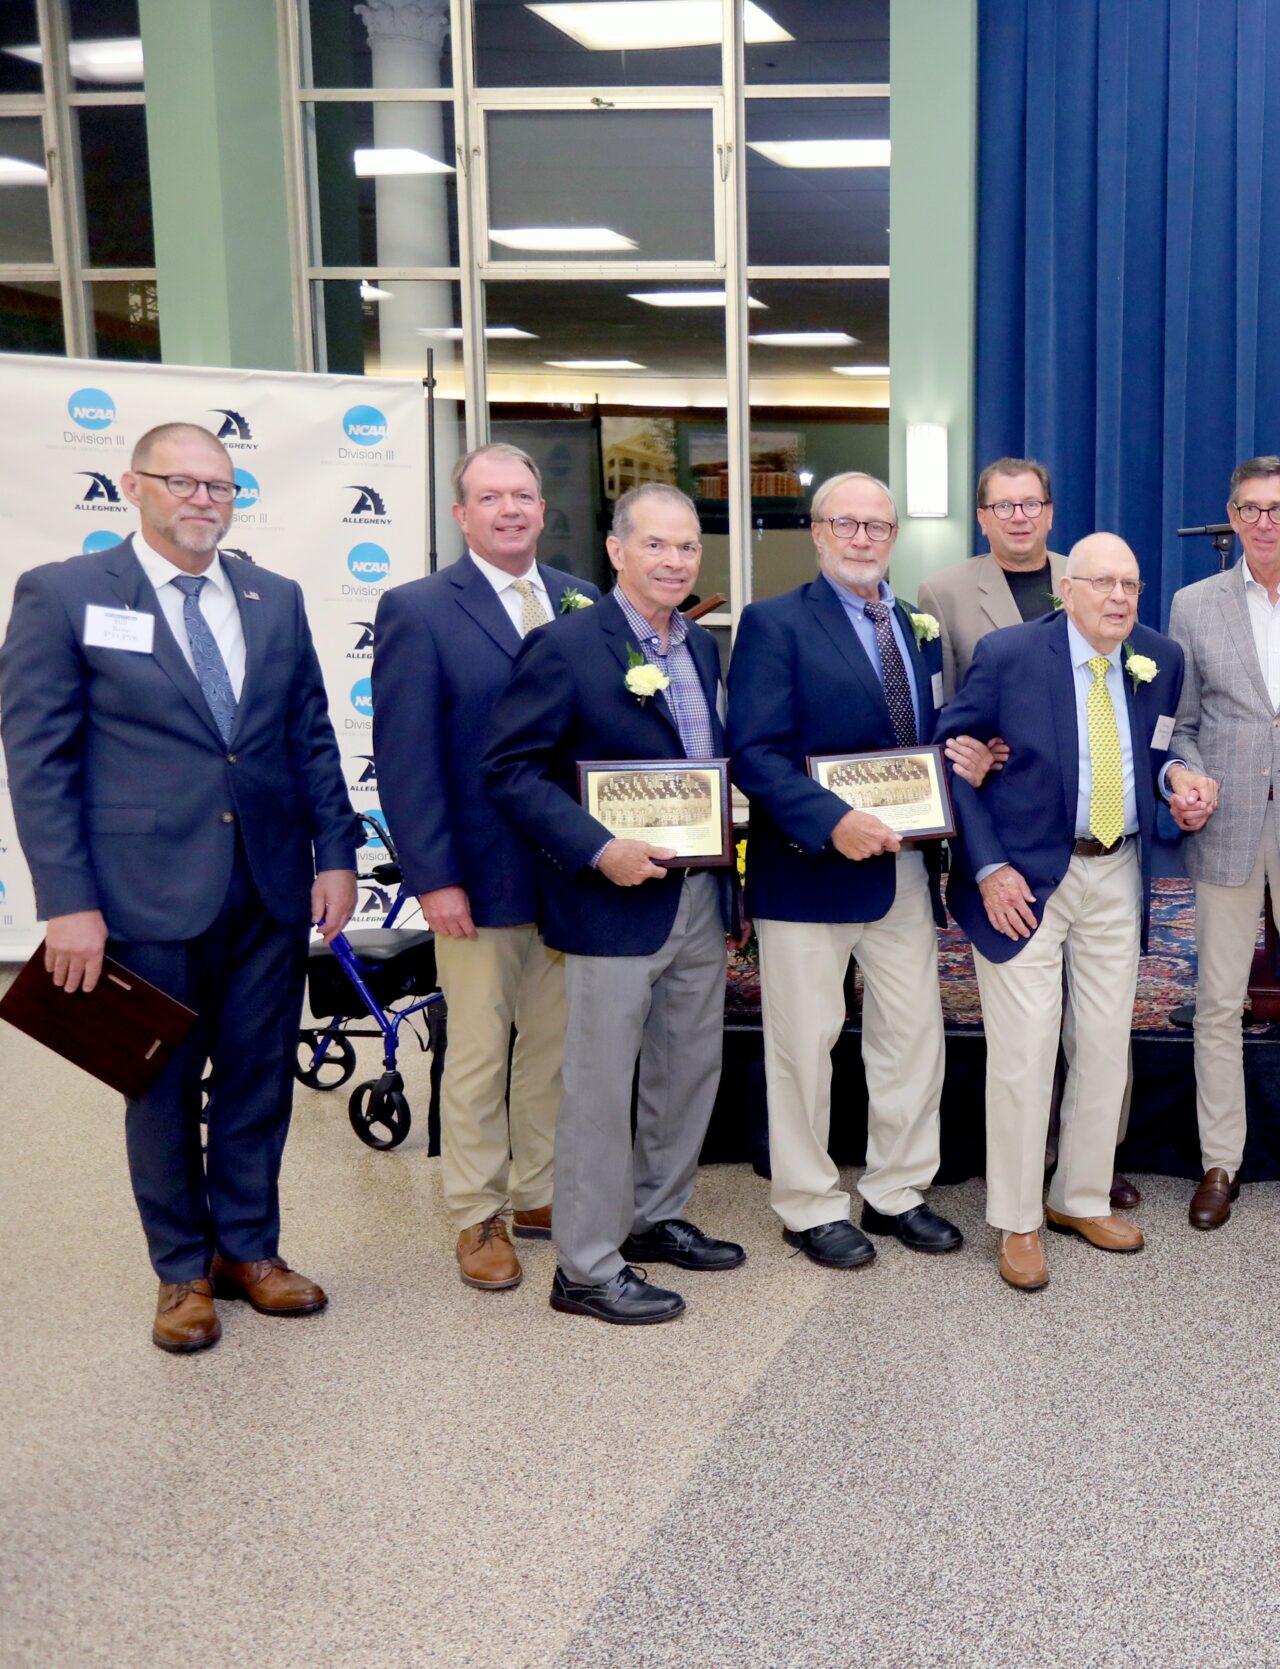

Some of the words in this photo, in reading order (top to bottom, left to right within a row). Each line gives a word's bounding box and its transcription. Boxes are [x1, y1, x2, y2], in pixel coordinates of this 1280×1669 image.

[73, 407, 115, 420] NCAA
[348, 424, 386, 436] NCAA
[63, 431, 112, 446] Division
[116, 435, 125, 446] III
[223, 442, 259, 450] EGHENY
[338, 447, 382, 461] Division
[385, 450, 394, 461] III
[75, 504, 128, 512] ALLEGHENY
[232, 512, 256, 523] sion
[342, 517, 392, 525] ALLEGHENY
[352, 561, 389, 573] NCAA
[344, 719, 372, 730] Divis
[357, 850, 390, 861] ivision
